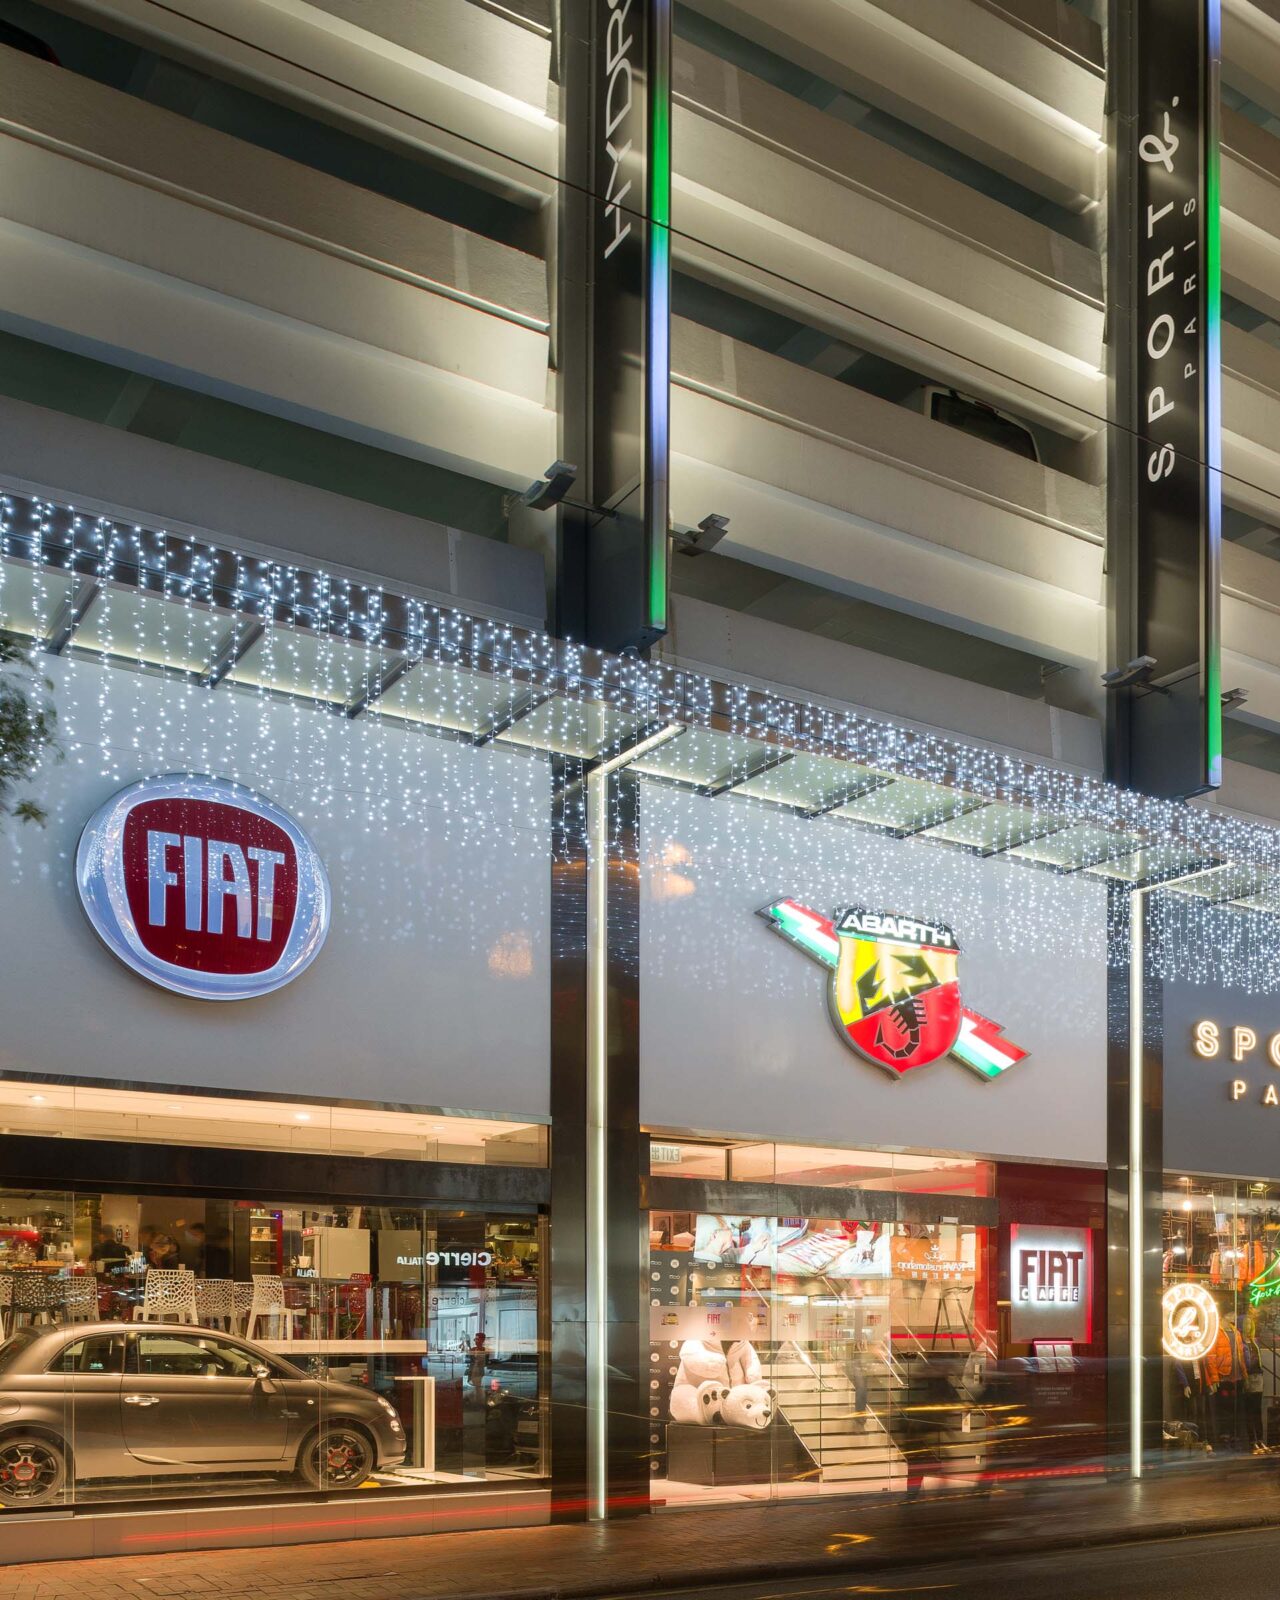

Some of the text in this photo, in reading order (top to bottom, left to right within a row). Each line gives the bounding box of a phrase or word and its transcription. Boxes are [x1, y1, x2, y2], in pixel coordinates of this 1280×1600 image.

[604, 0, 633, 259] HYDR
[1146, 201, 1176, 483] SPORT
[1183, 198, 1197, 380] PARIS
[147, 830, 285, 942] FIAT
[842, 914, 951, 947] ABARTH
[1019, 1250, 1084, 1287] FIAT
